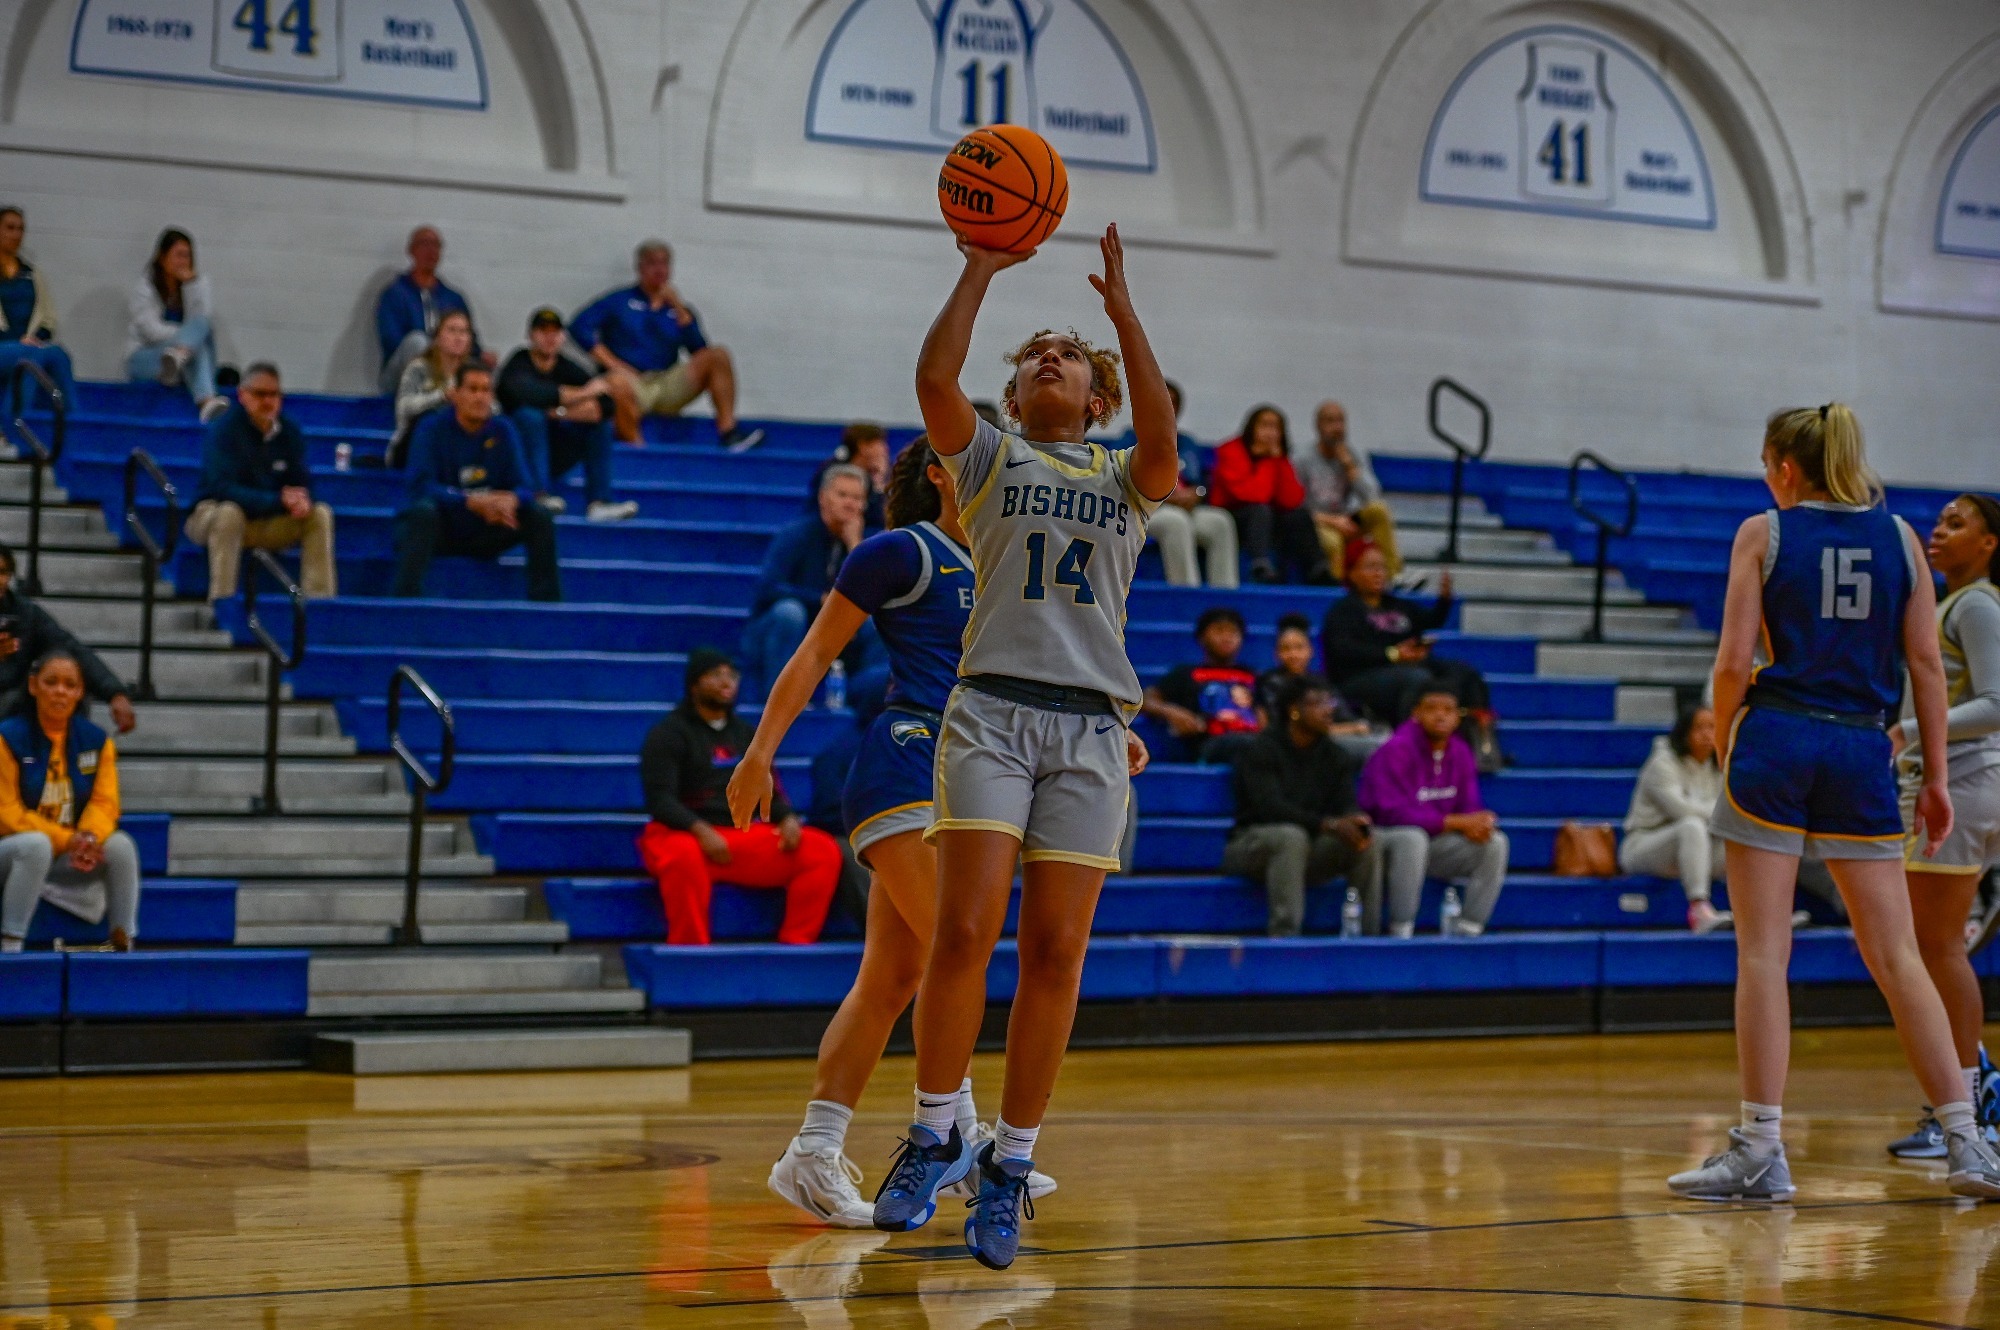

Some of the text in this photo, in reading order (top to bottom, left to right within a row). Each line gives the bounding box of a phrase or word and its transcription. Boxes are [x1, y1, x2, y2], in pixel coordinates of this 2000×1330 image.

[231, 0, 321, 58] 44
[957, 58, 1014, 127] 11
[1537, 117, 1591, 187] 41
[1001, 484, 1129, 537] BISHOPS
[957, 587, 977, 610] E
[1021, 530, 1098, 607] 14
[1821, 547, 1872, 619] 15
